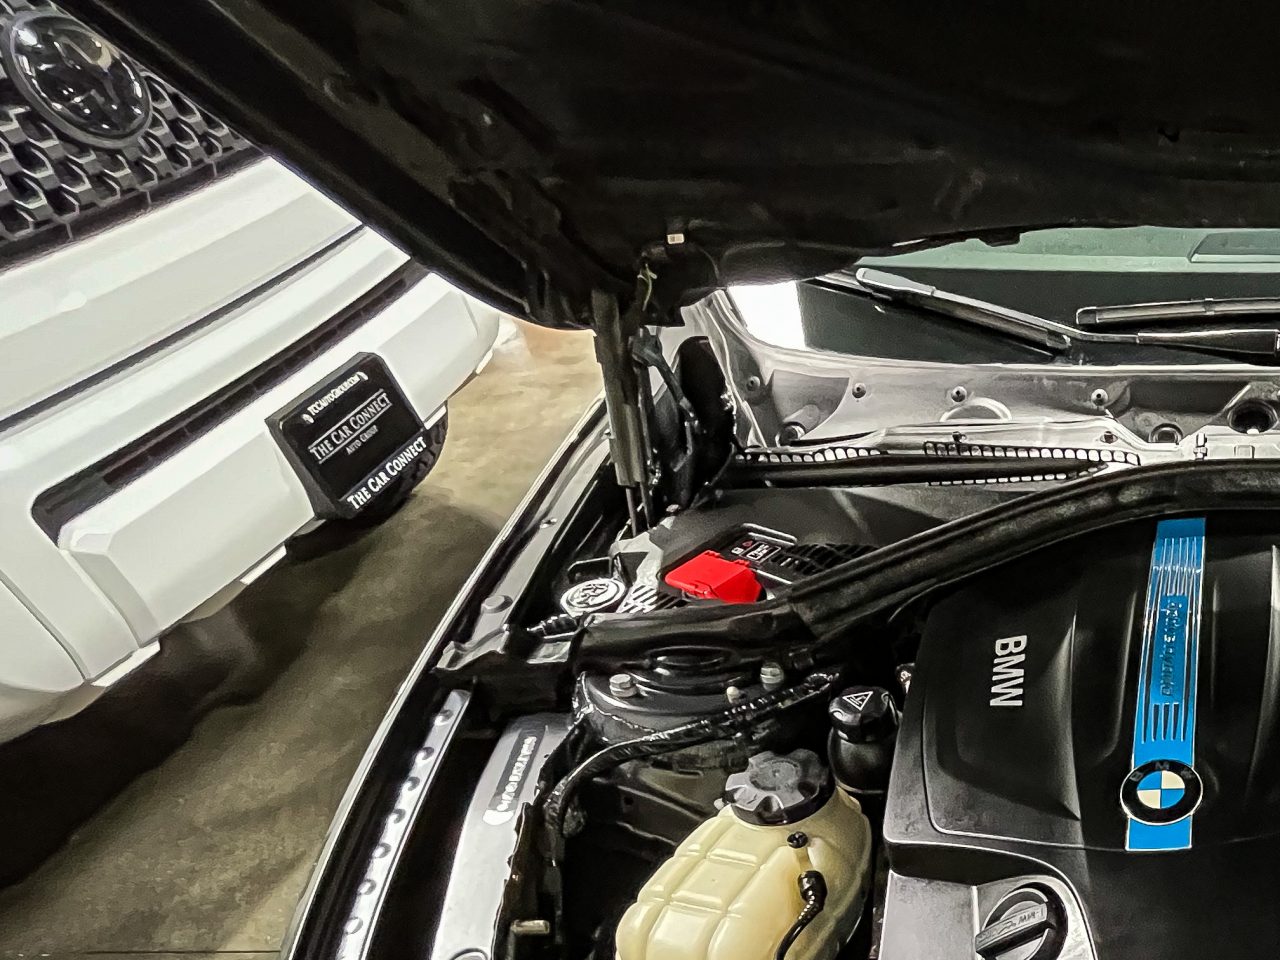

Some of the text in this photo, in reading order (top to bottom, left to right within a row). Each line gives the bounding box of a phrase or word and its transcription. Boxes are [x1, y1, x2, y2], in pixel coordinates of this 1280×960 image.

[310, 392, 393, 461] THE CAR CONNECT
[347, 437, 427, 511] THE CAR CONNECT
[990, 634, 1027, 708] BMW
